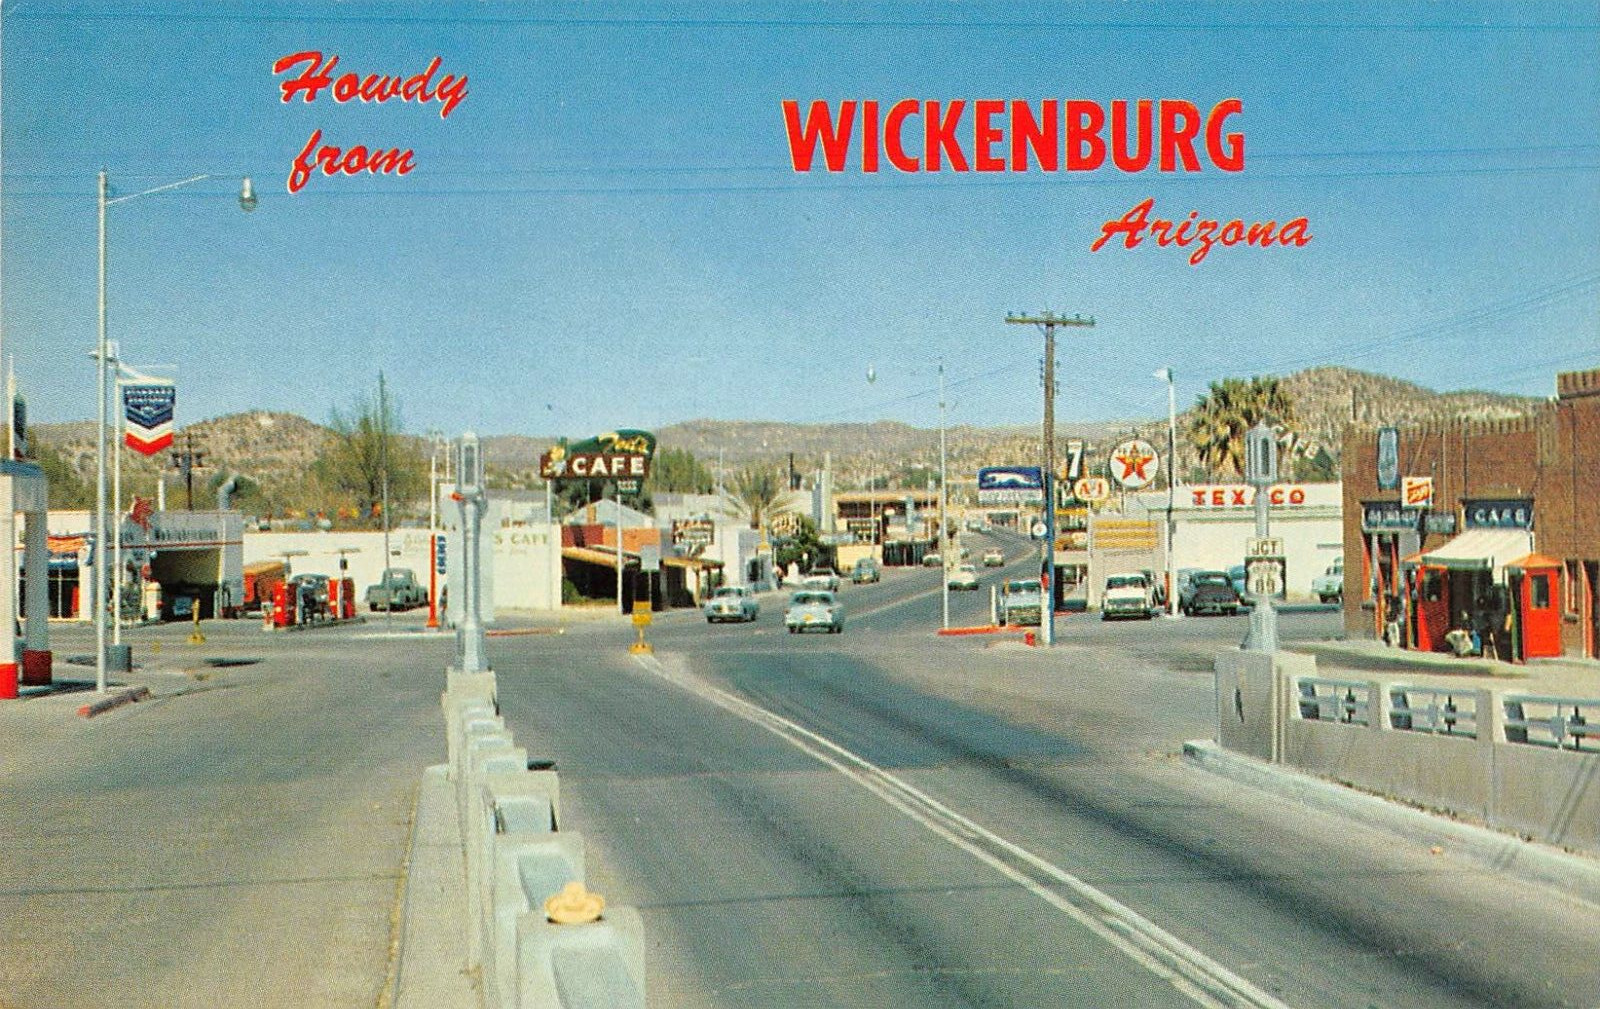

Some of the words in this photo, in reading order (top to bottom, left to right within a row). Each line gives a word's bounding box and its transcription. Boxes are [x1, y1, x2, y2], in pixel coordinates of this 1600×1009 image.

[571, 456, 645, 477] CAFE
[1191, 487, 1305, 505] TEXCO
[1251, 540, 1278, 555] JCT
